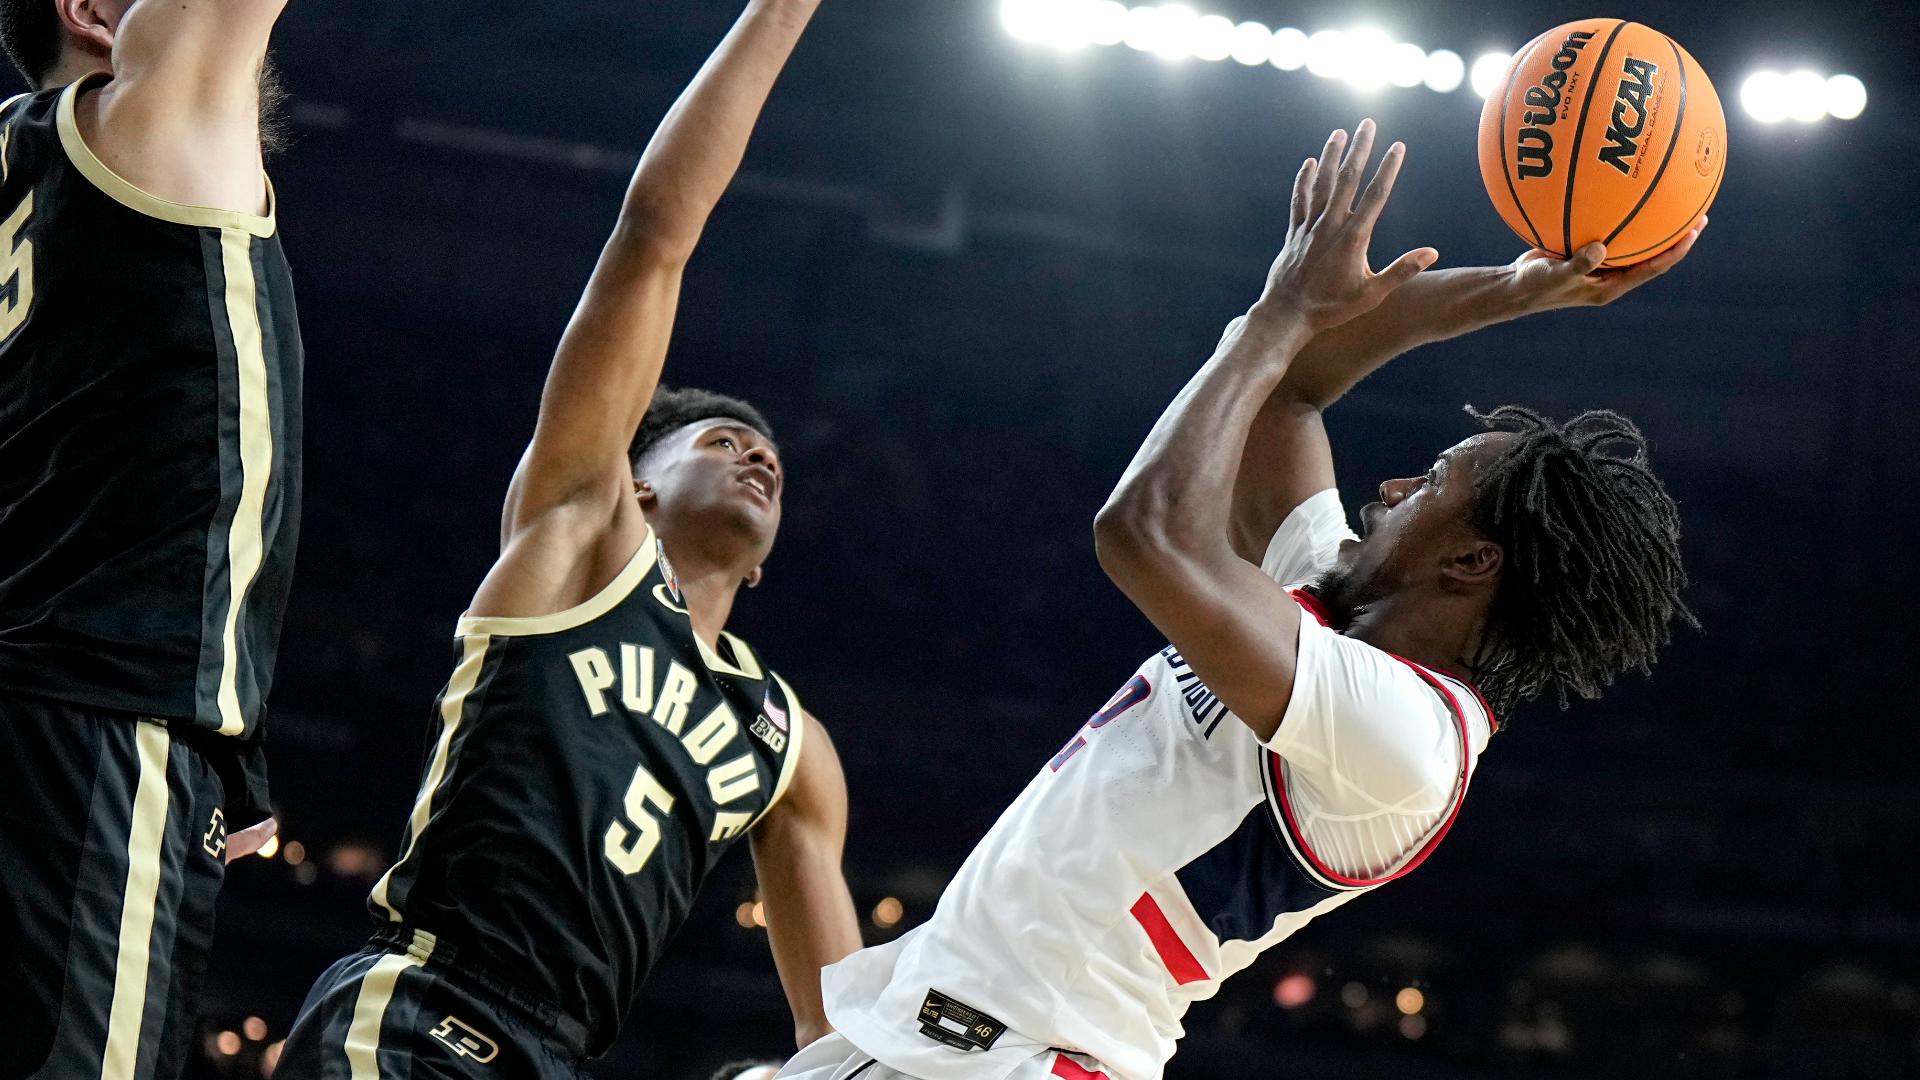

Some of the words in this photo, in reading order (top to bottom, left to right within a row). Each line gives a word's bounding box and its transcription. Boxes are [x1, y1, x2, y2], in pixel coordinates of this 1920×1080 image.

[1516, 29, 1597, 181] Wilson
[1561, 96, 1571, 119] EVO
[1568, 71, 1580, 93] NXT
[1597, 55, 1658, 176] NCAA
[567, 641, 760, 841] PURDUE
[604, 762, 677, 876] 5
[974, 1023, 993, 1038] 46
